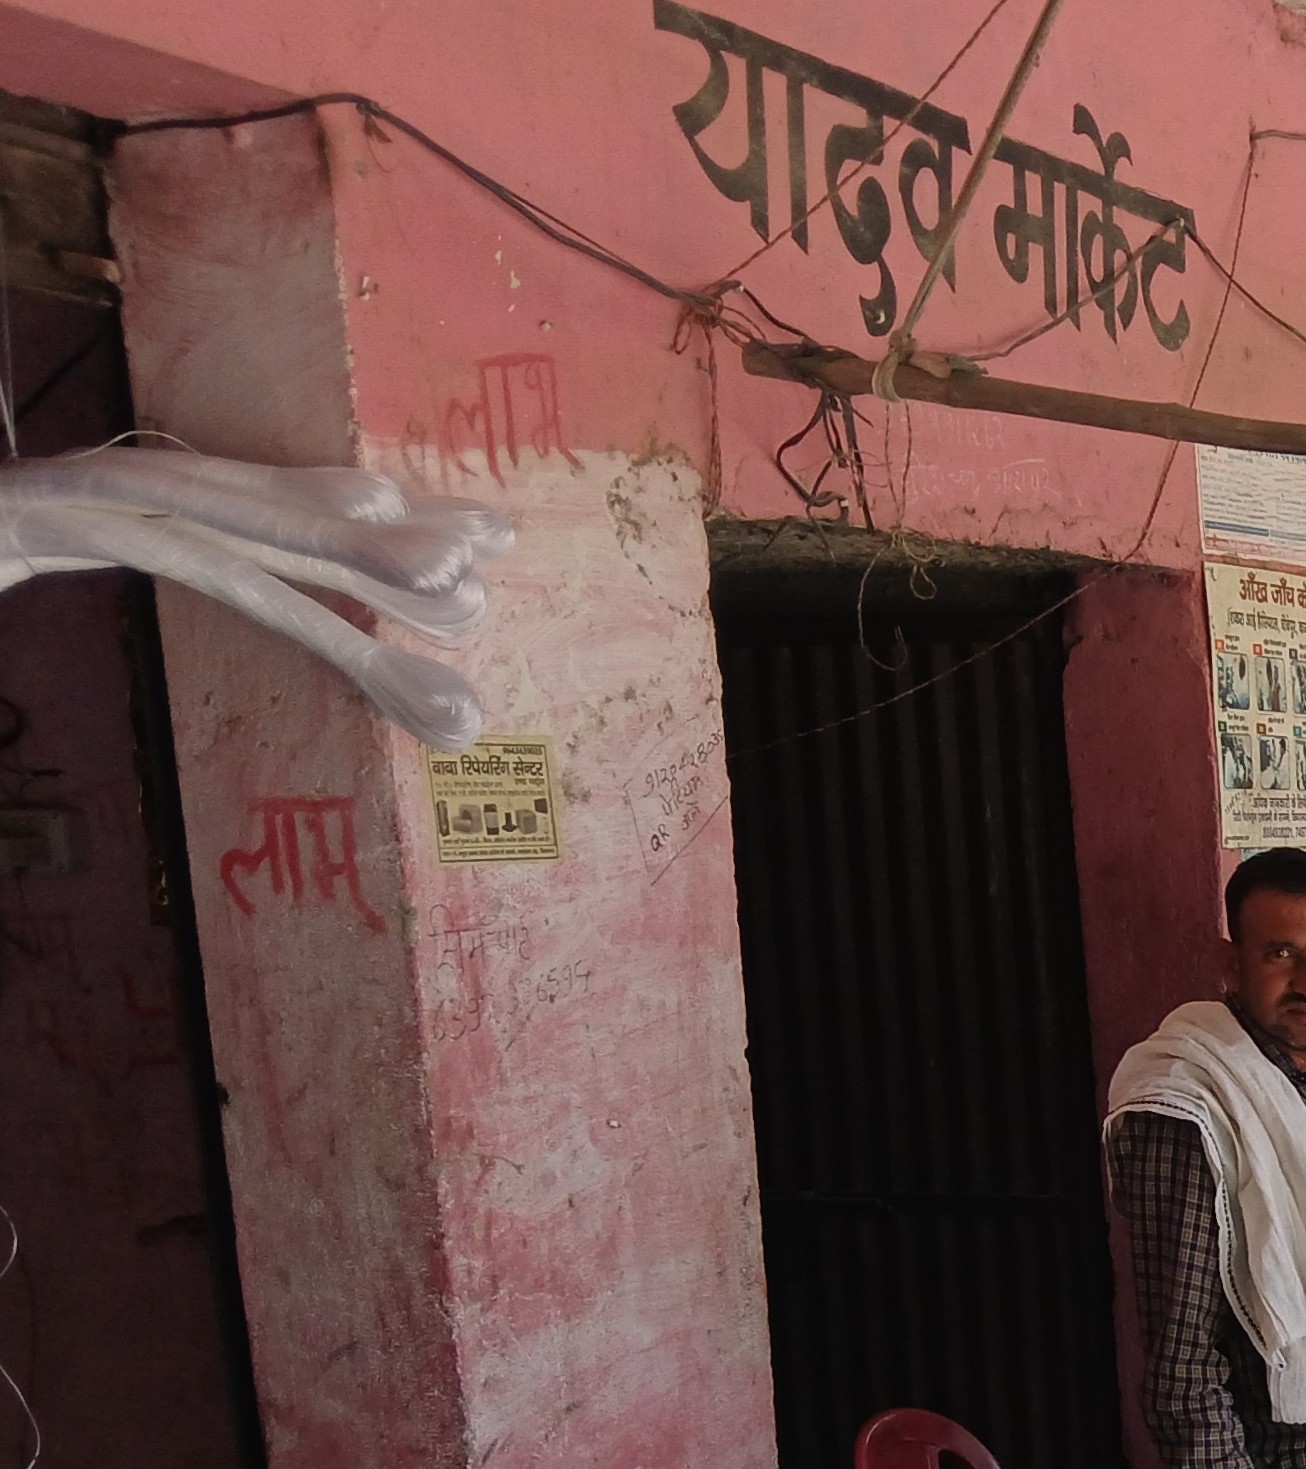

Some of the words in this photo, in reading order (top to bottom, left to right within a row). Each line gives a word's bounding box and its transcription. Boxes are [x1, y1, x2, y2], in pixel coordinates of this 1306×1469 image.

[653, 0, 972, 336] यादव
[991, 102, 1195, 352] मार्केट
[1239, 571, 1268, 603] आँख
[1270, 577, 1295, 607] जाँच
[460, 754, 510, 776] रिपेयरिंग
[512, 756, 544, 777] सेन्टर
